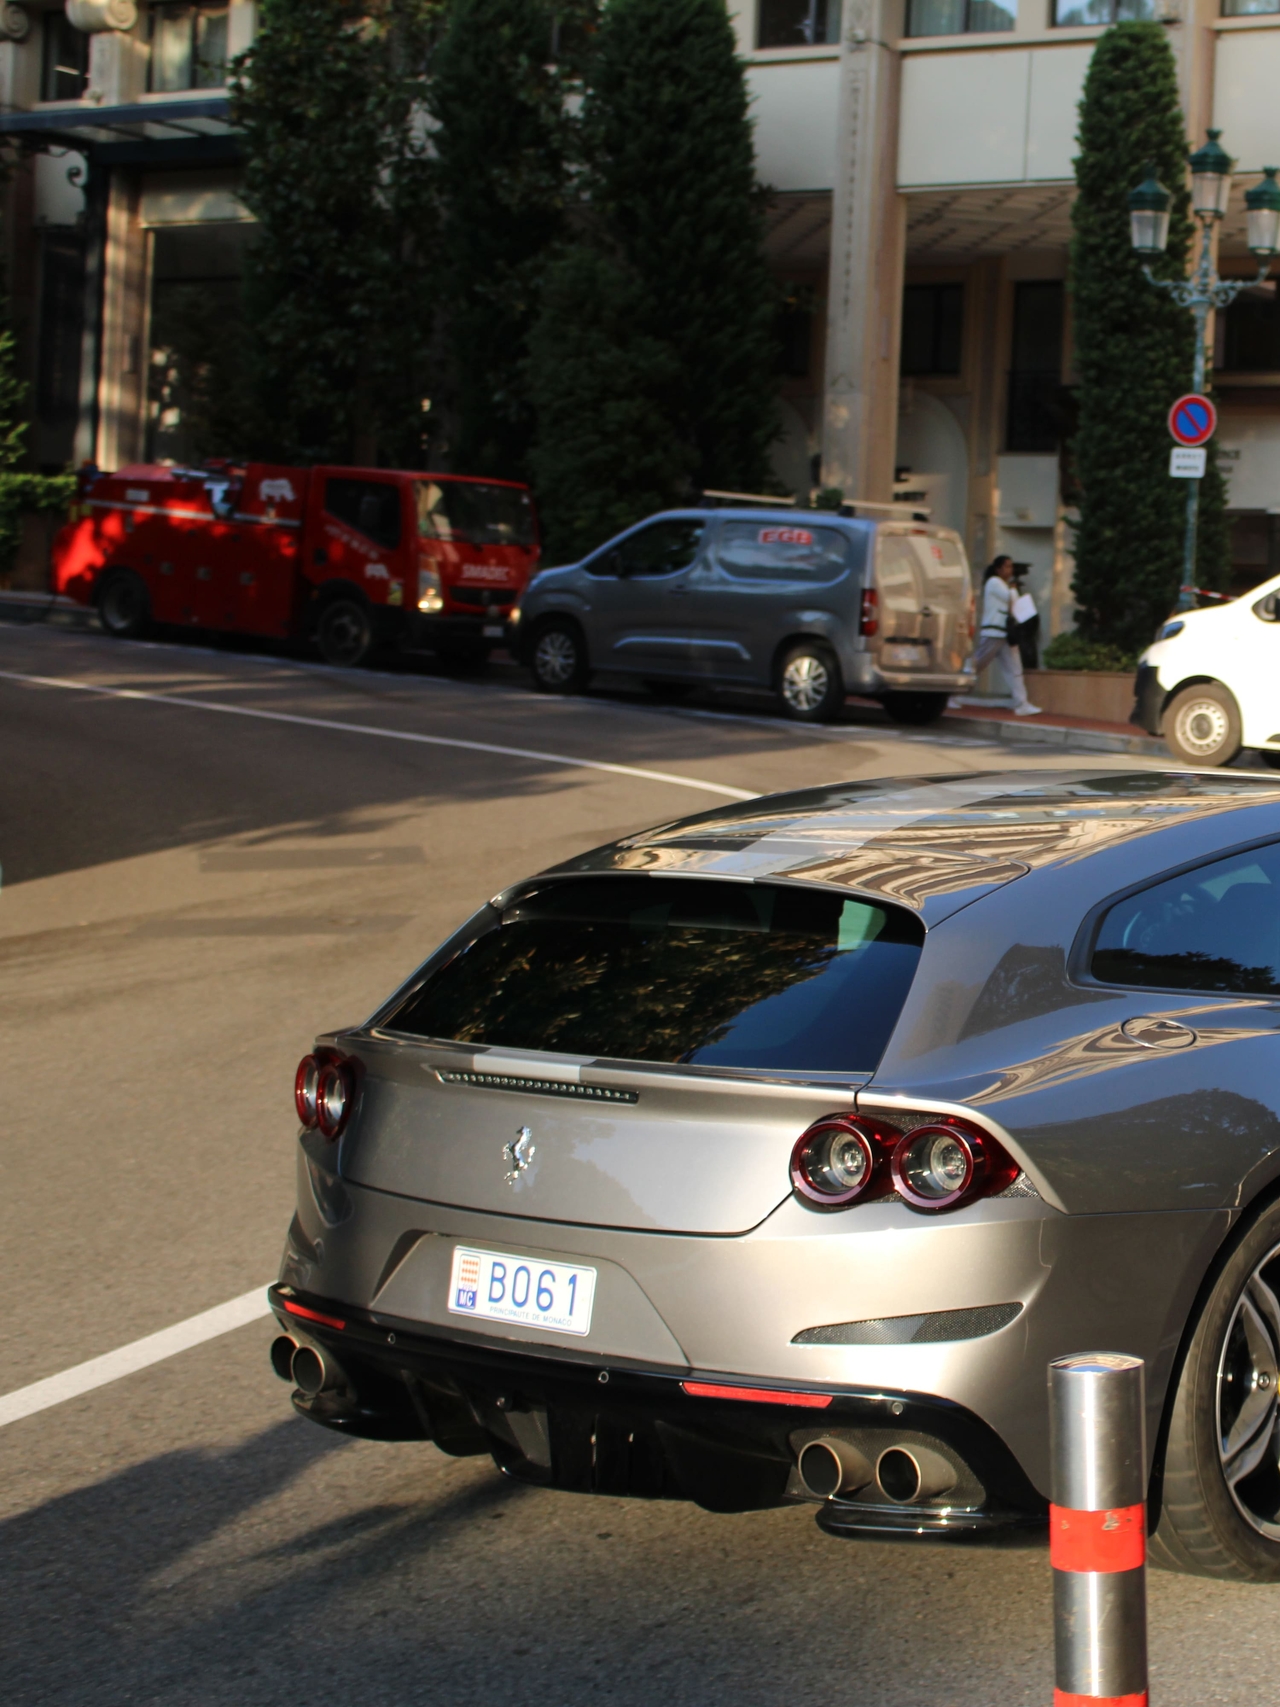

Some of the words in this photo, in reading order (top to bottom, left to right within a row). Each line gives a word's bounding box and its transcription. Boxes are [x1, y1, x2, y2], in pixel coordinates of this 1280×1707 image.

[459, 1291, 474, 1307] MC
[488, 1262, 577, 1316] B061
[489, 1306, 530, 1319] PRINCIPAUTE
[532, 1312, 540, 1321] DE
[543, 1313, 572, 1327] MONACO
